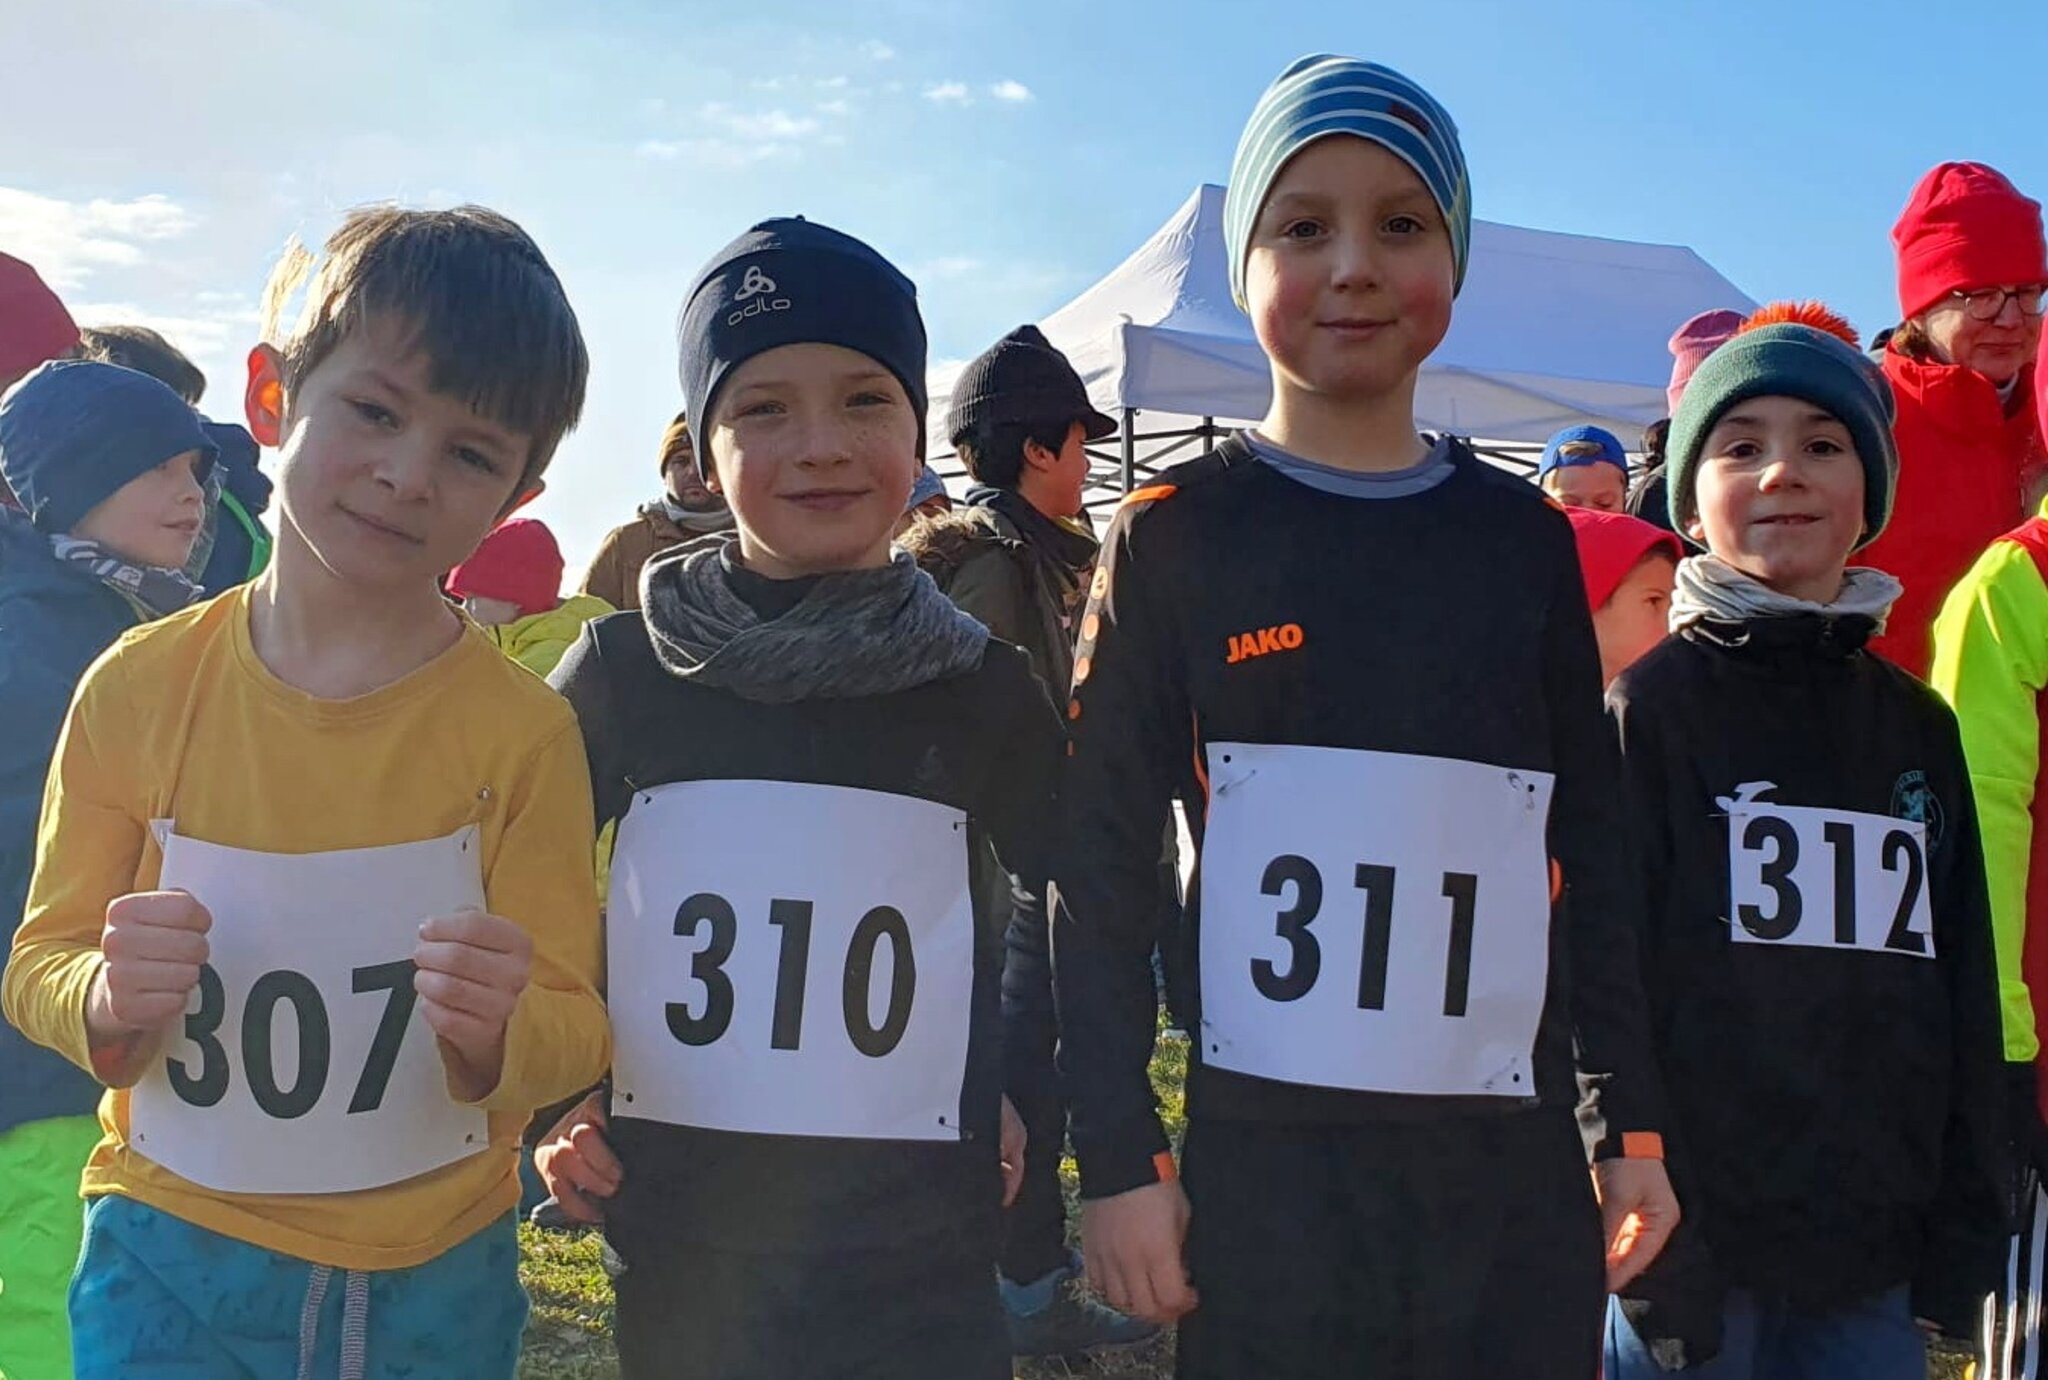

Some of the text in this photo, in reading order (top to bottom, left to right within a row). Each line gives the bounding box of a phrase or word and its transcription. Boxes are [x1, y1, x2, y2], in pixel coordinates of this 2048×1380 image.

[727, 296, 791, 326] odlo
[1226, 623, 1304, 664] JAKO
[1250, 854, 1478, 1017] 311
[1738, 815, 1927, 953] 312
[166, 958, 420, 1119] 307
[664, 892, 917, 1058] 310
